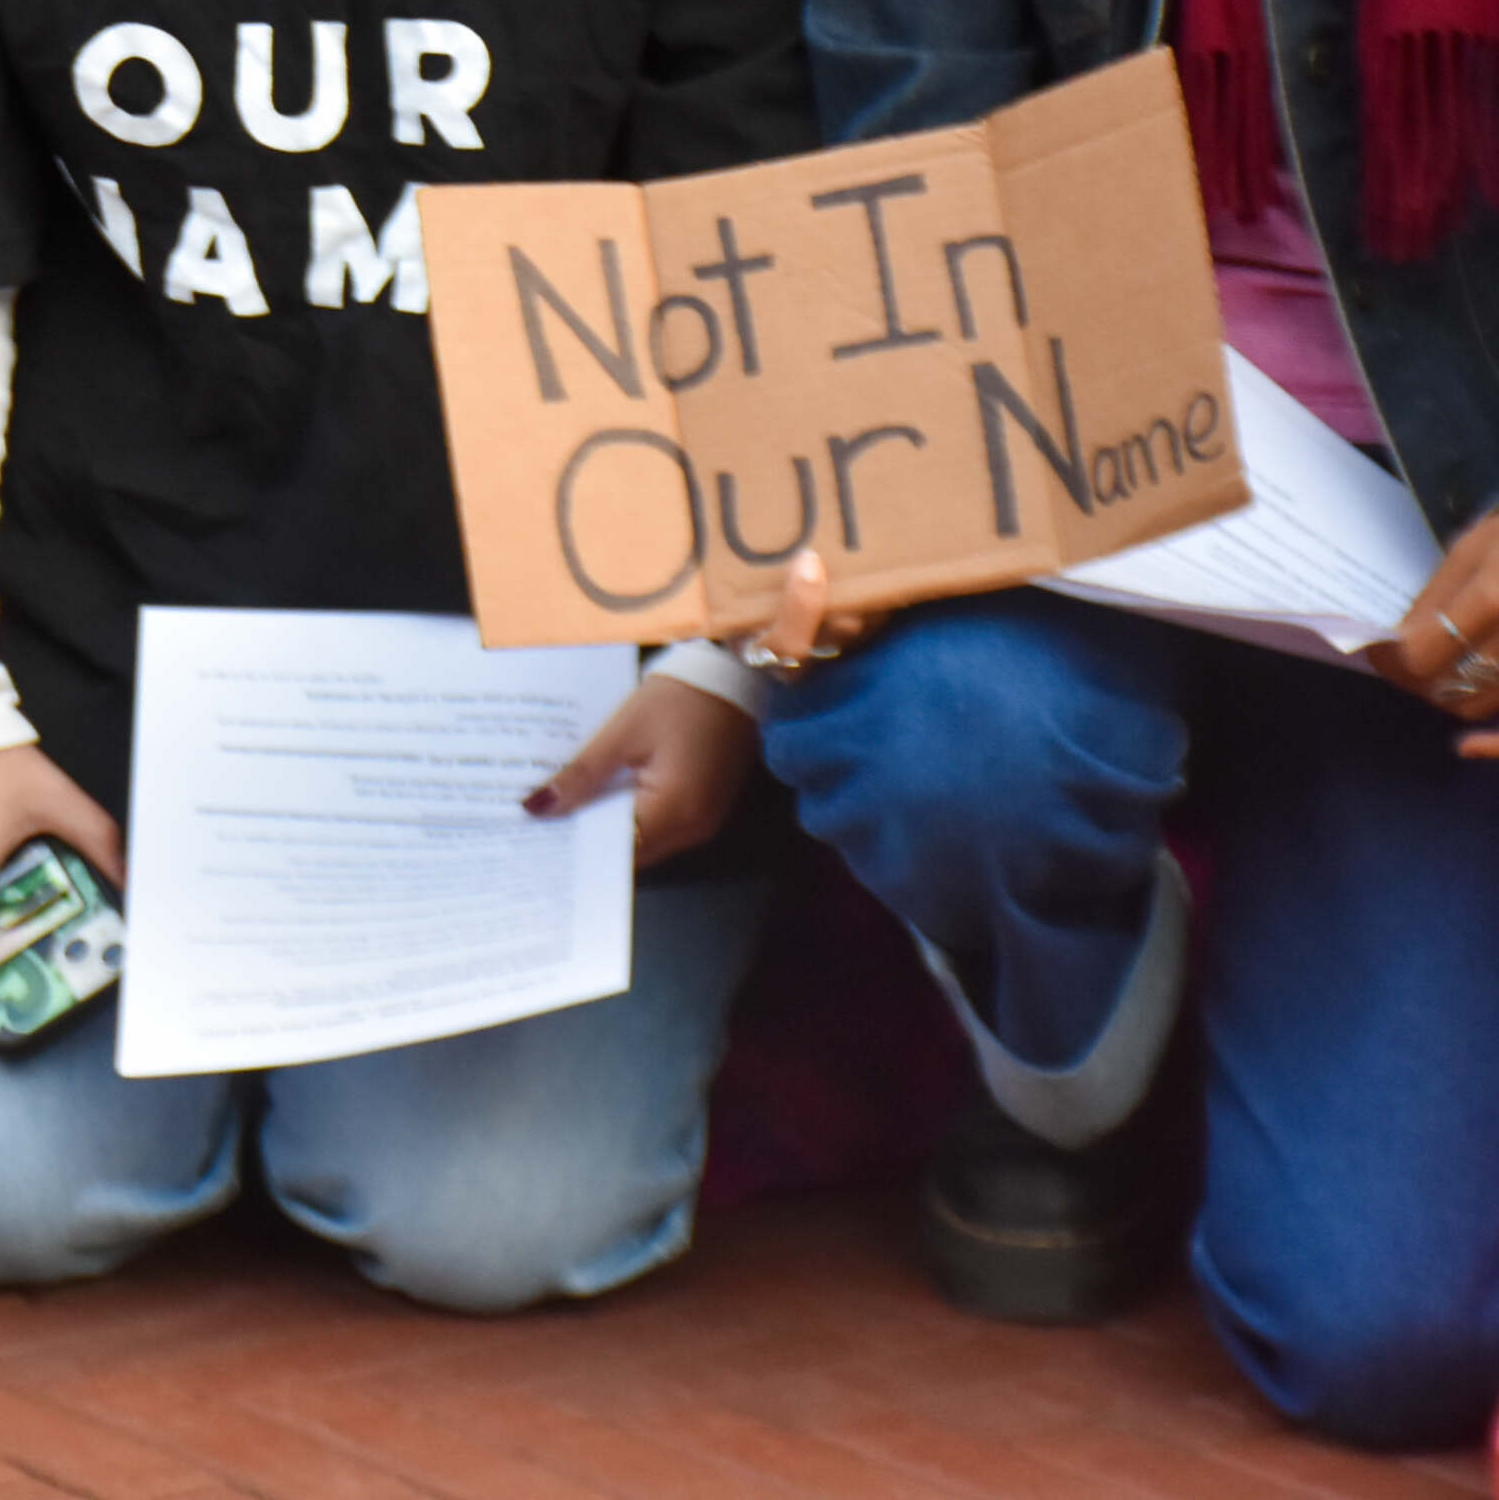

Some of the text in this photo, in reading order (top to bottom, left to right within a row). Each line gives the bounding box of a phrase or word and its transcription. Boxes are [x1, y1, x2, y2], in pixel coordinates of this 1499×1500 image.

[72, 18, 491, 152] OUR
[507, 174, 1028, 402] Not In
[556, 425, 928, 612] Our
[971, 337, 1224, 538] Name
